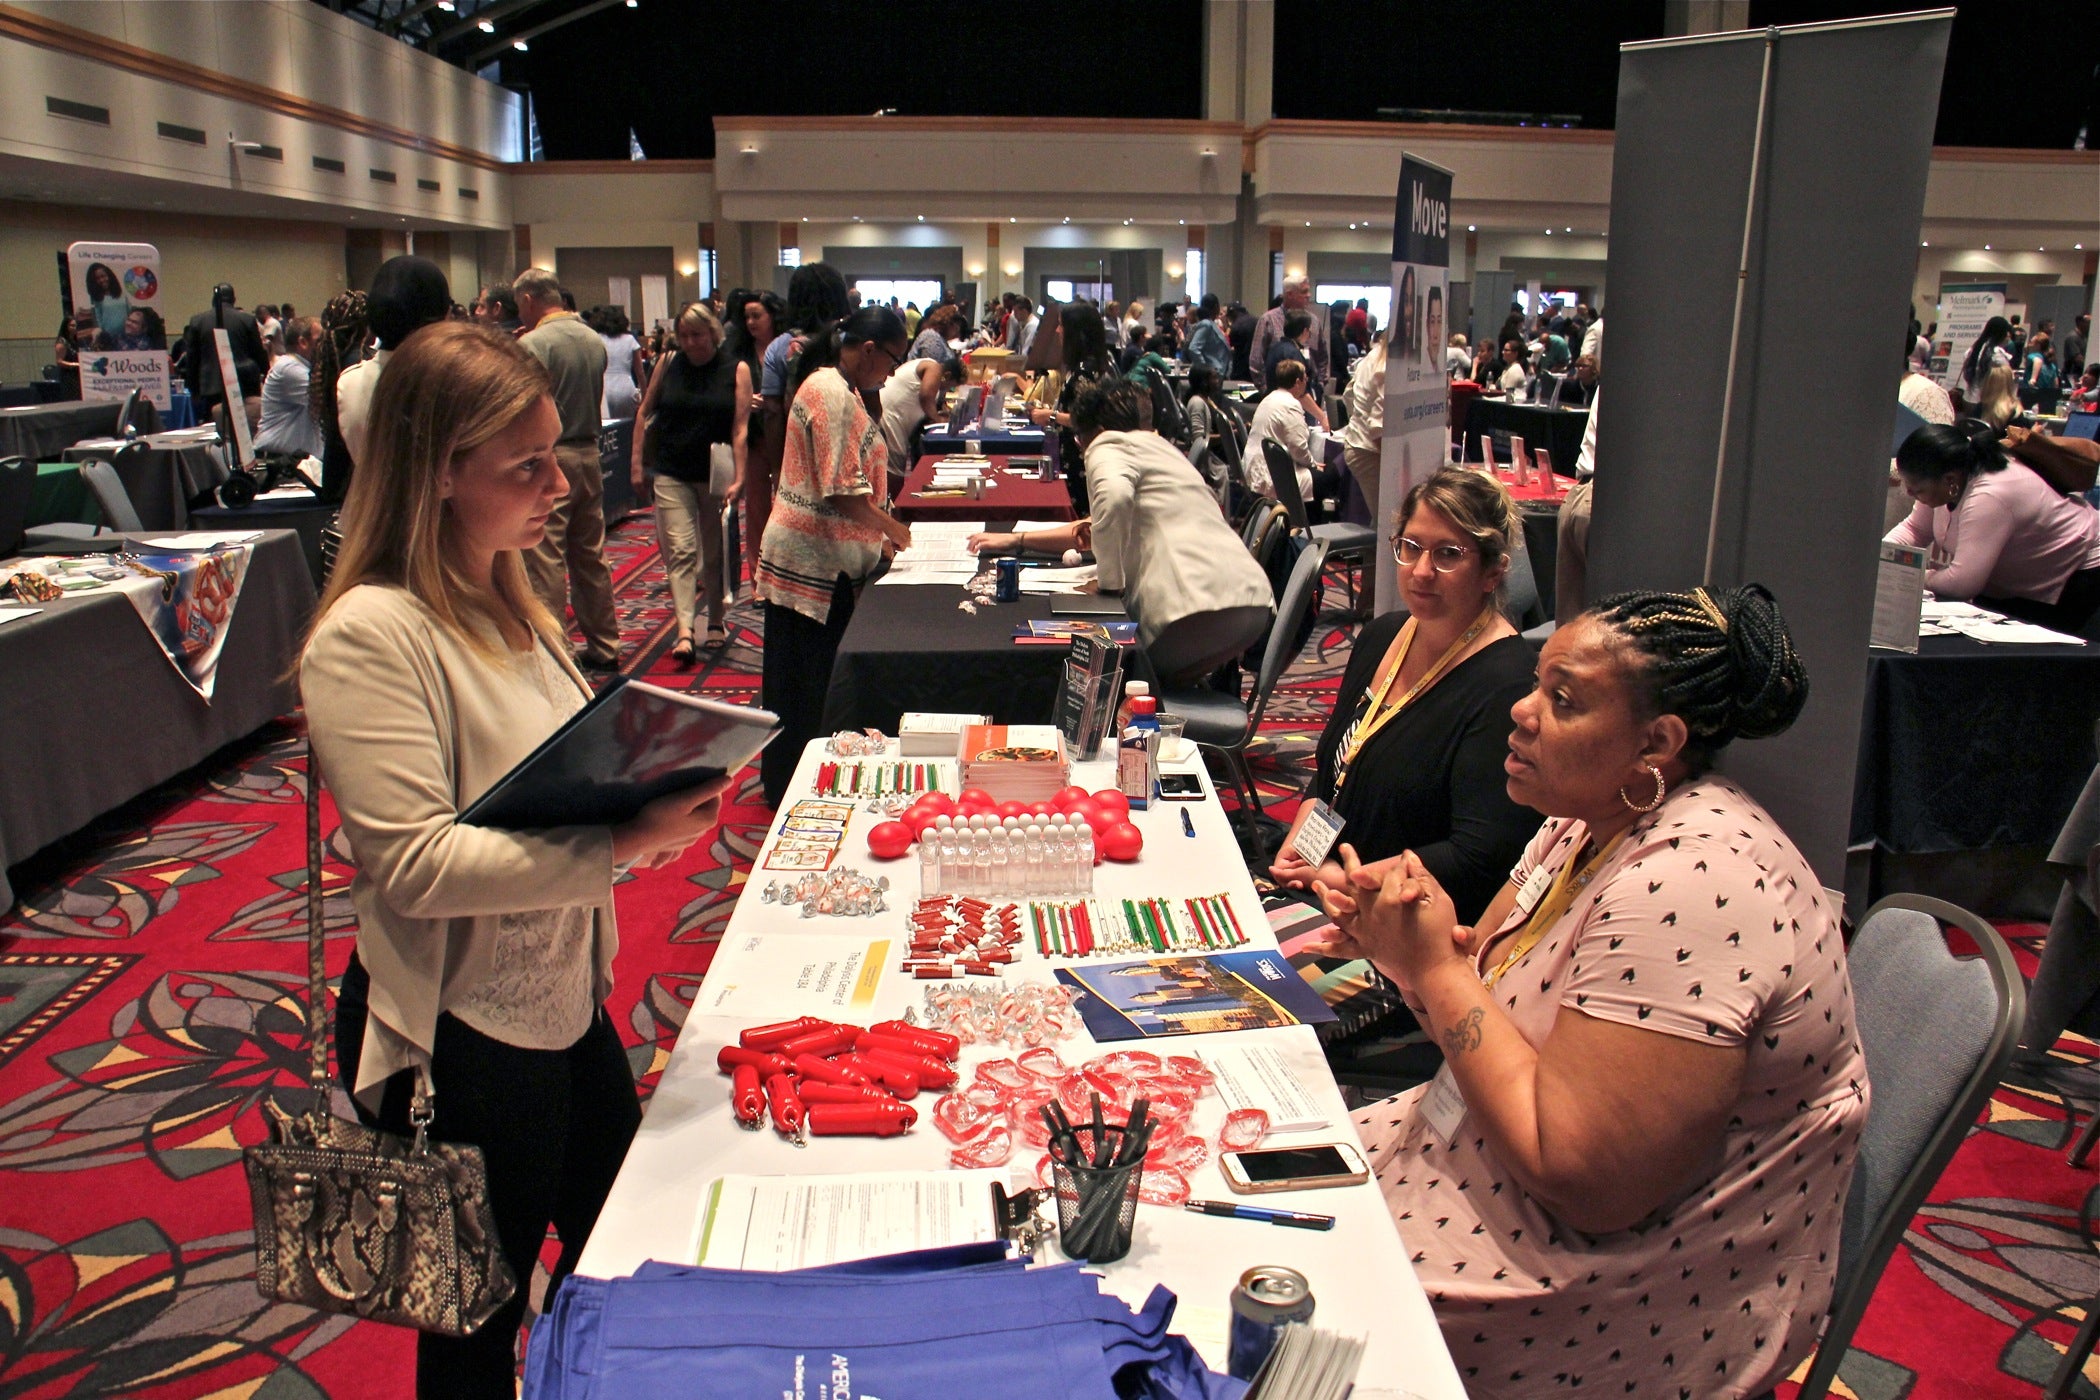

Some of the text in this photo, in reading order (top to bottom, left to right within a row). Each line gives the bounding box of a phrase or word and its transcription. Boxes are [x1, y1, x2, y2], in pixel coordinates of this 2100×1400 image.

[1412, 180, 1446, 239] Move
[78, 251, 91, 259] Life
[93, 252, 126, 261] Changing
[110, 358, 162, 374] Woods
[800, 964, 816, 978] Table
[815, 962, 837, 993] Philadelphia
[833, 952, 861, 1006] The Dialysis Center of
[832, 1354, 850, 1400] AMERIC
